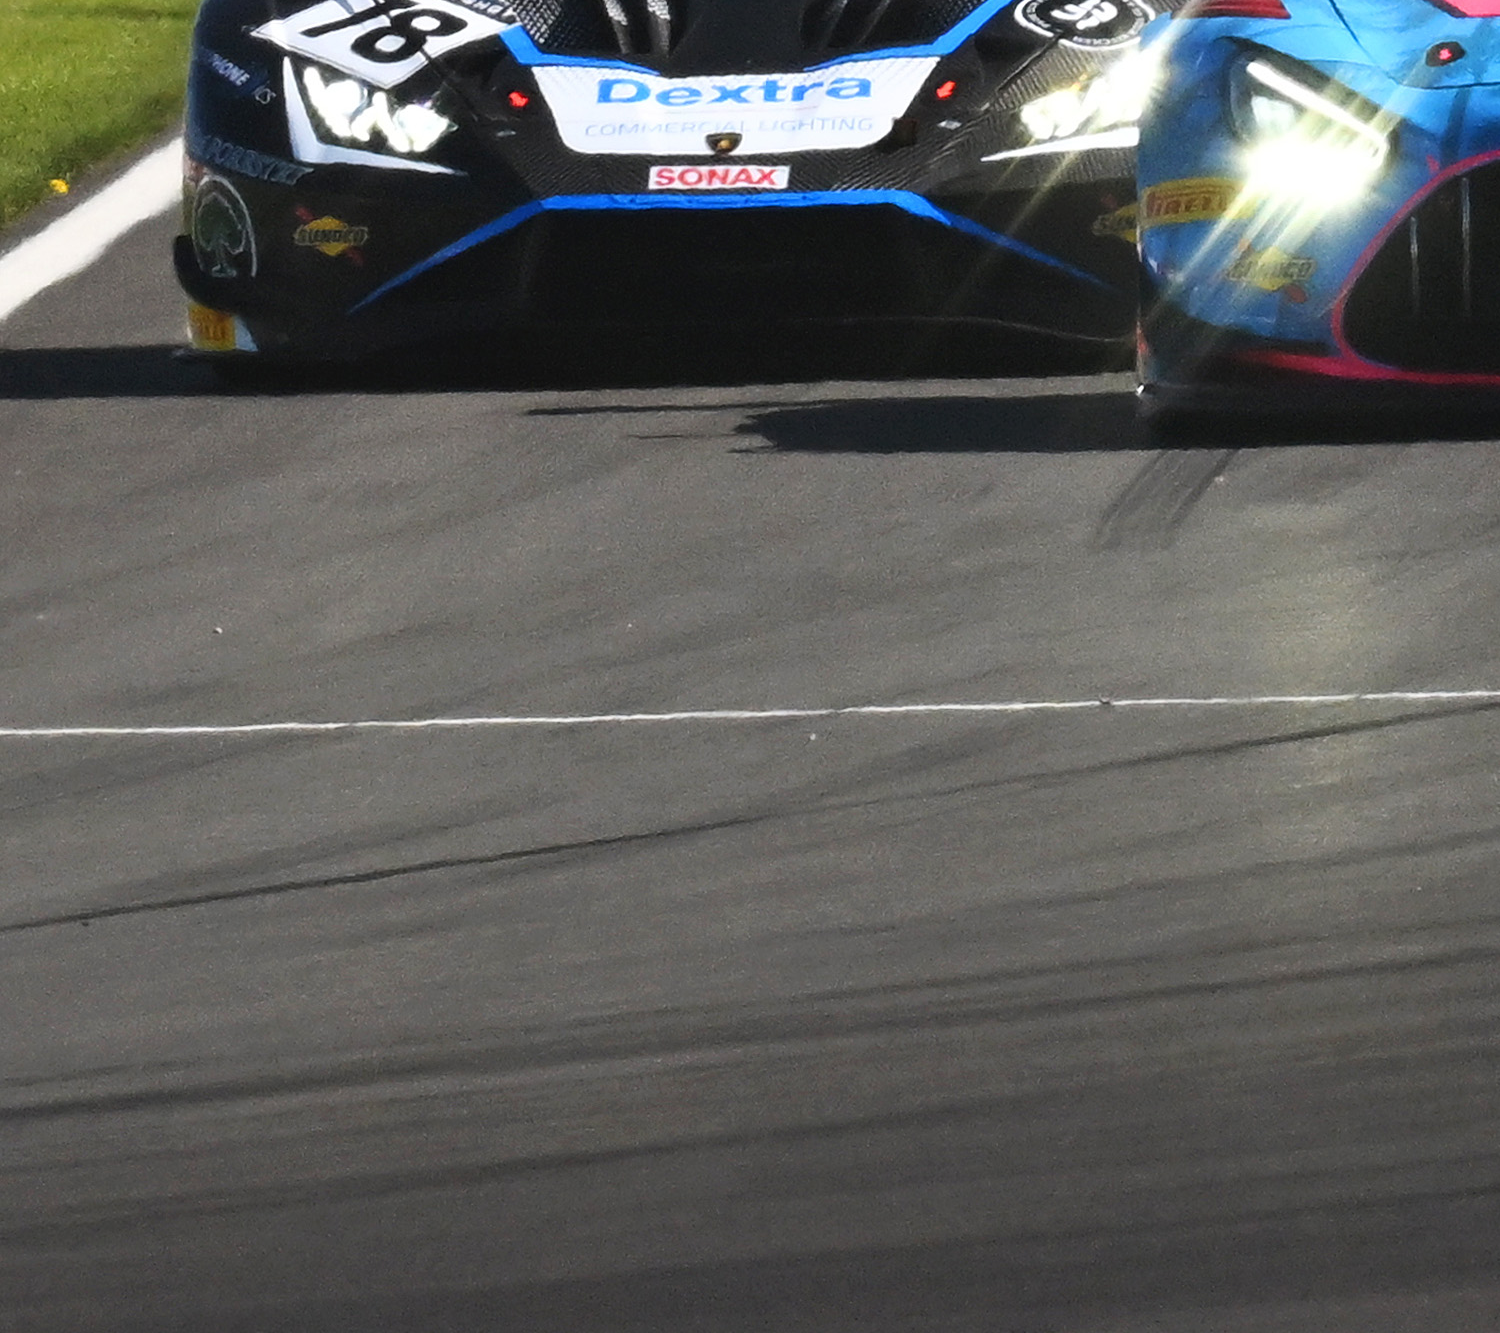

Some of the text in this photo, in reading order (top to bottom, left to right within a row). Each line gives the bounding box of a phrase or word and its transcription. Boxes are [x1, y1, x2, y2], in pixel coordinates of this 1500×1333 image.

[596, 77, 873, 107] Dextra
[584, 117, 873, 137] COMMERCIAL LIGHTING
[655, 168, 777, 187] SONAX
